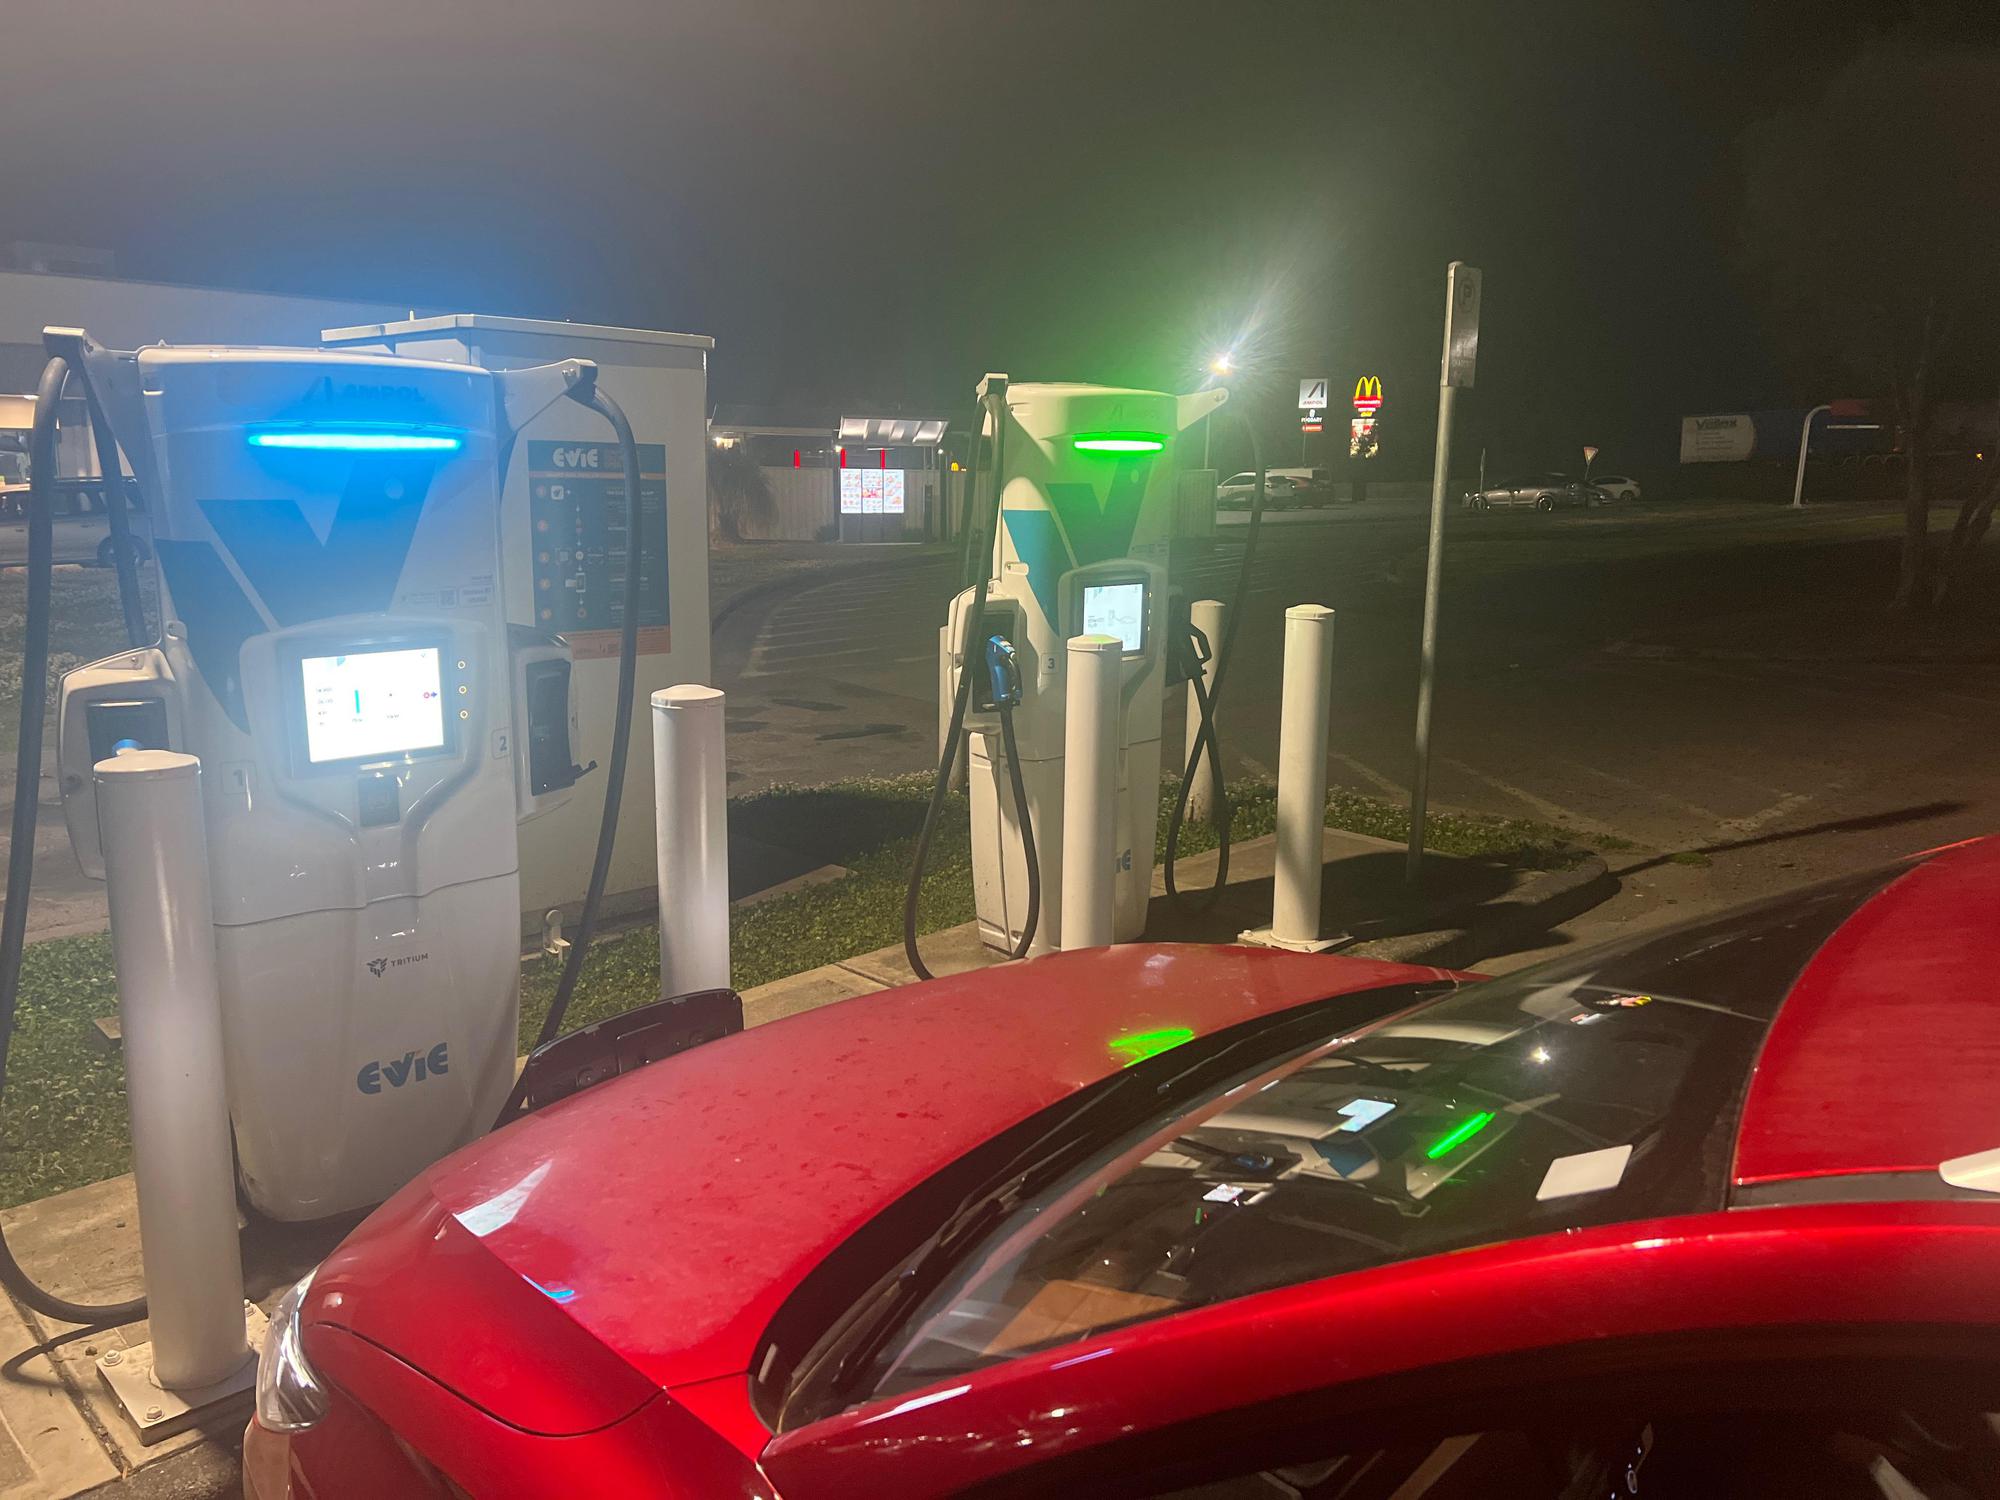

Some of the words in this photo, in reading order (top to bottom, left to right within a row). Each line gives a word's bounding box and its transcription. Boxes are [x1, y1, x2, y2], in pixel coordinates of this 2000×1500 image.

[1047, 657, 1055, 669] 3
[499, 735, 508, 752] 2
[232, 768, 244, 787] 1
[391, 952, 429, 967] TRITIUM
